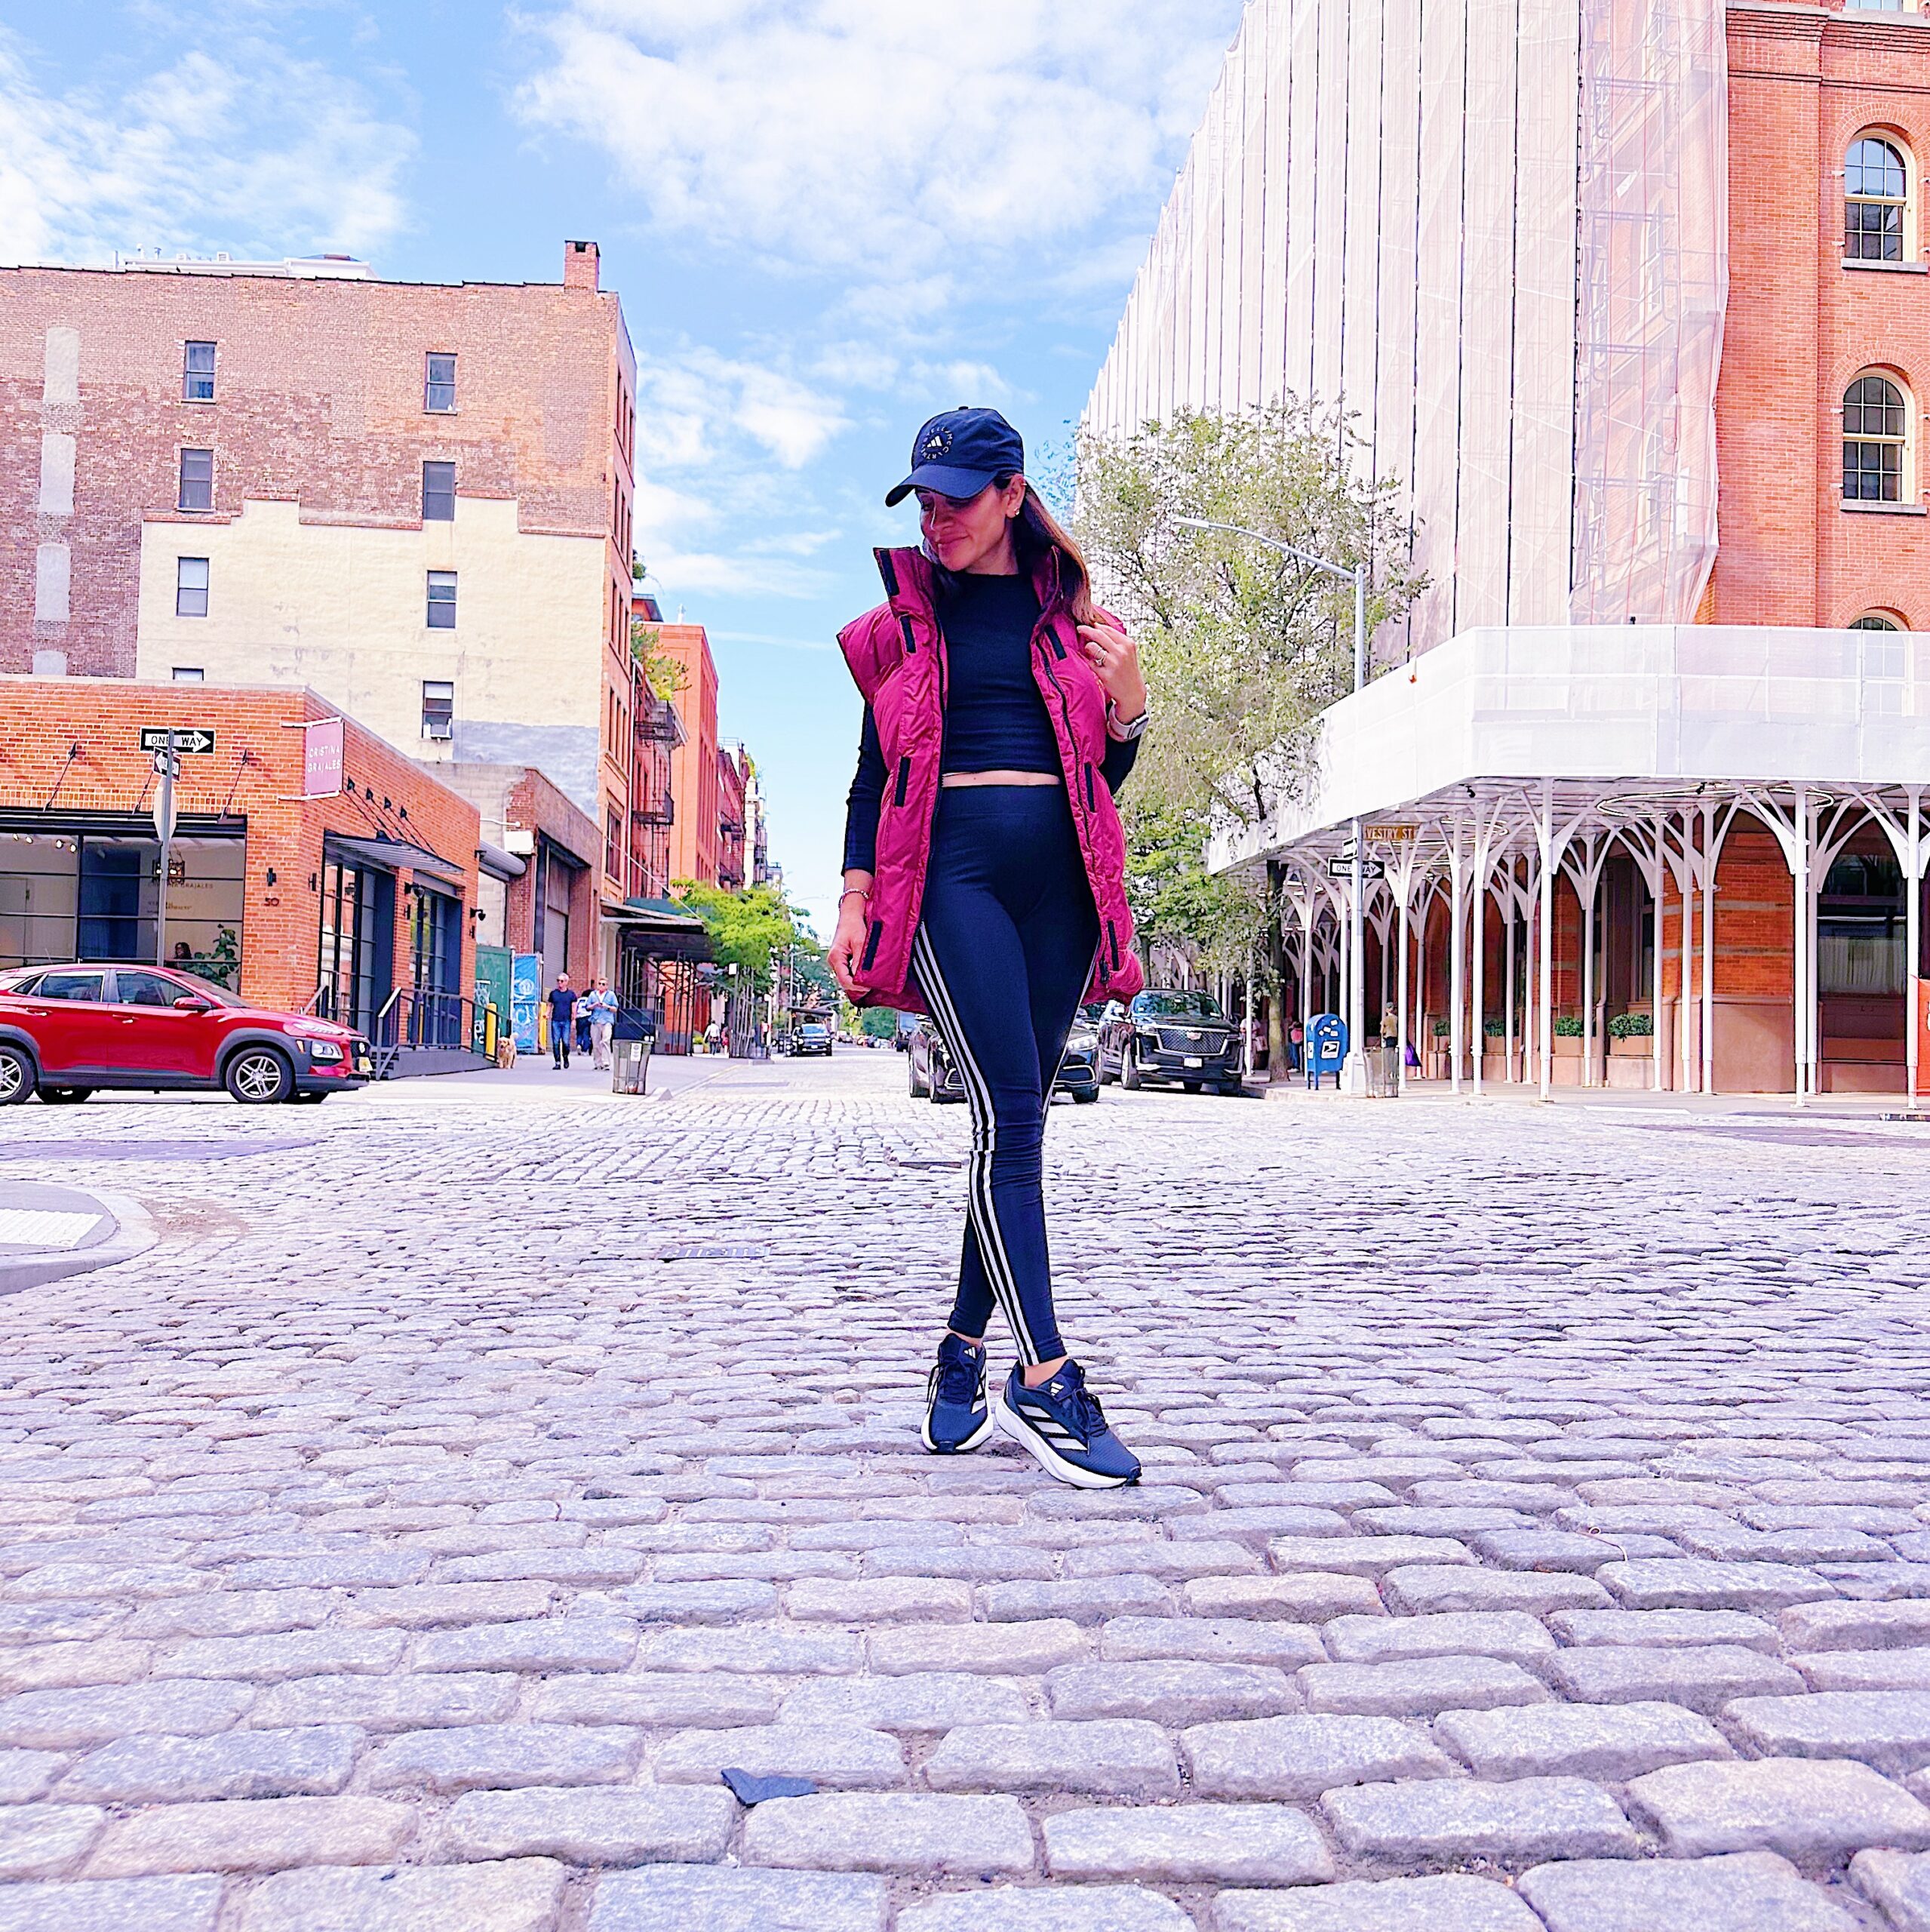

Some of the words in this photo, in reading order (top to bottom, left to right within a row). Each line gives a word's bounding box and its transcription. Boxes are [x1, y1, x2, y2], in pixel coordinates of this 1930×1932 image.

[181, 737, 203, 746] WAY
[309, 745, 340, 758] CRISTINA
[307, 758, 341, 774] GRAJALES
[1366, 827, 1398, 840] VESTRY
[1402, 827, 1412, 840] ST
